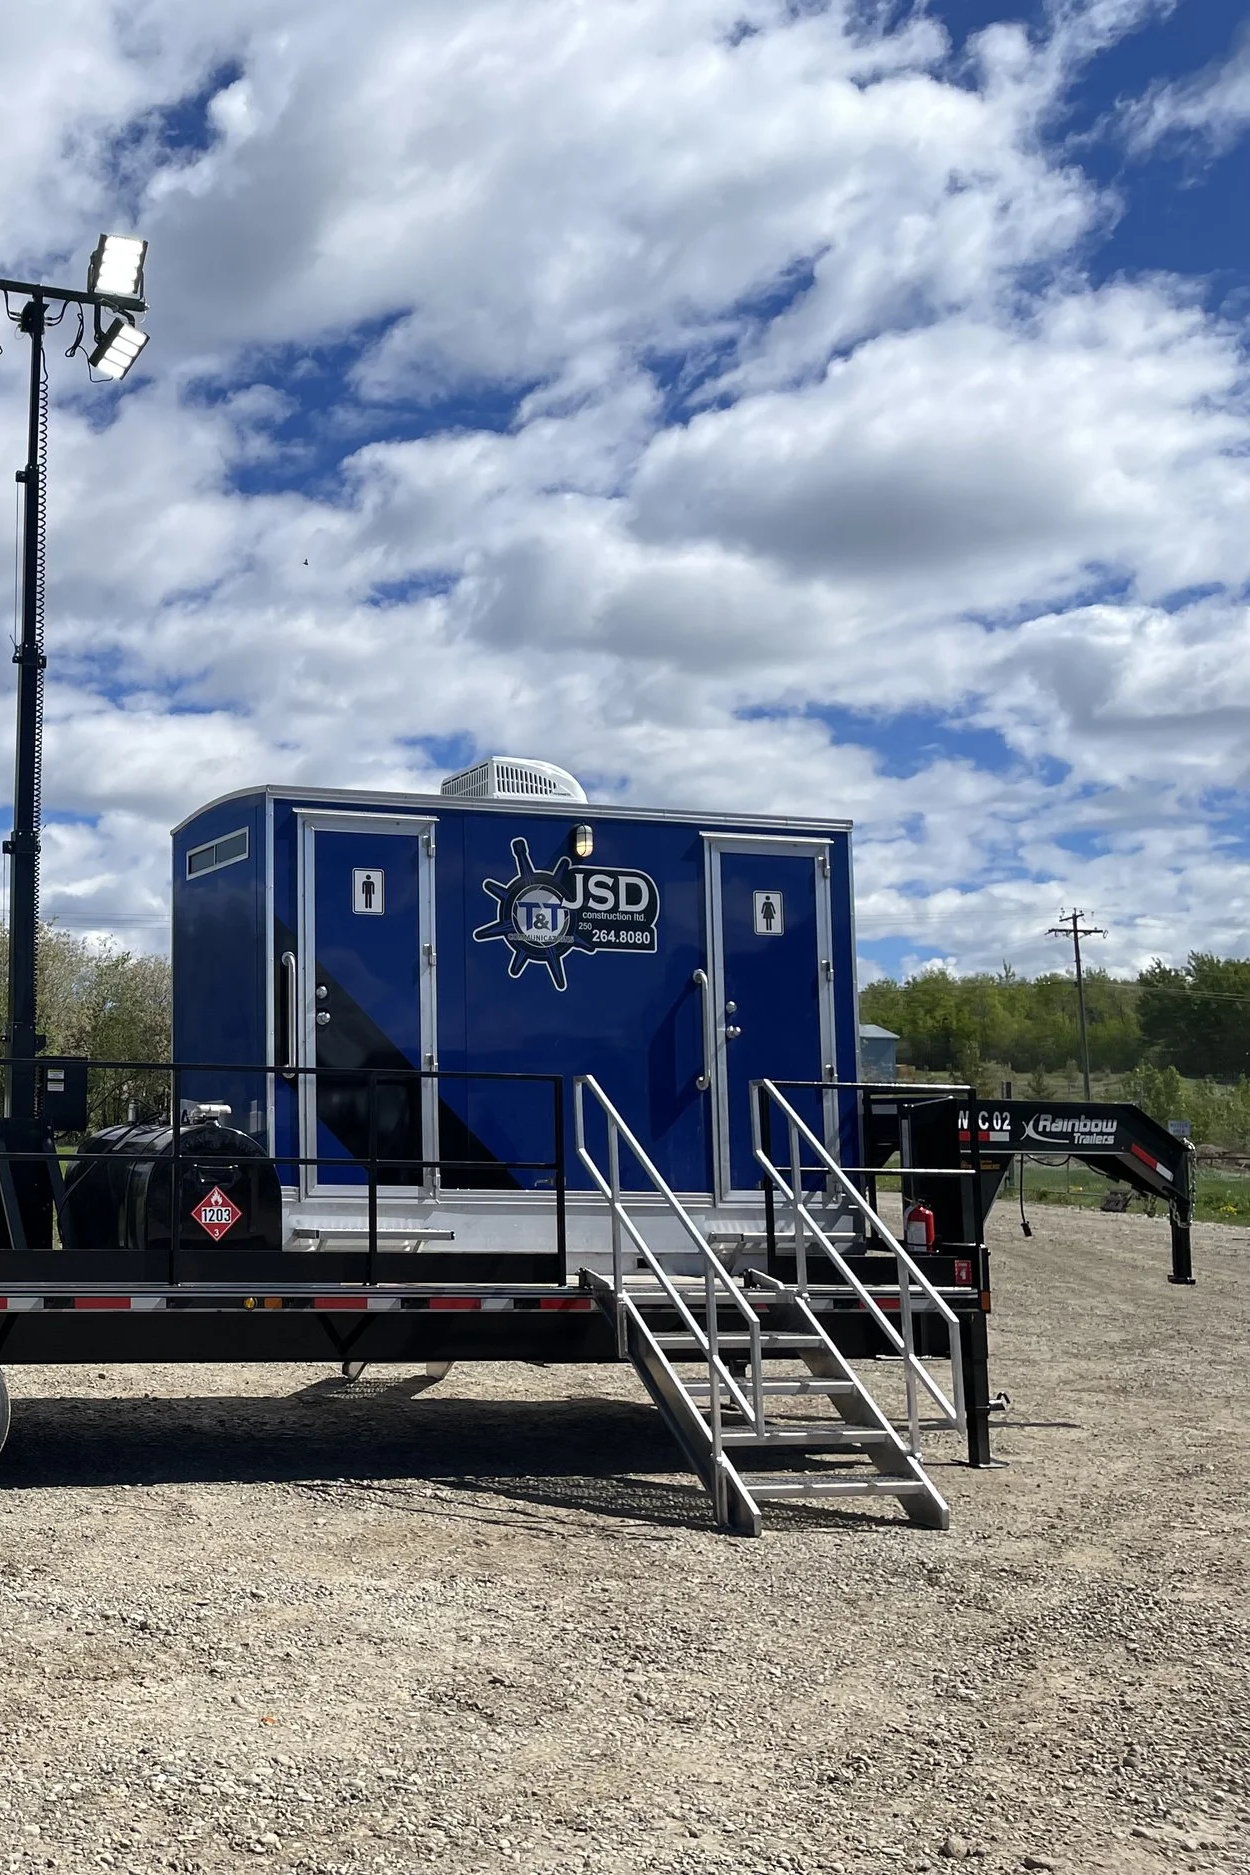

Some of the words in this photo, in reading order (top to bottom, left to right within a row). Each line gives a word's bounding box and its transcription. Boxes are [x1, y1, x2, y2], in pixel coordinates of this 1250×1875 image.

[561, 873, 650, 912] JSD
[517, 900, 563, 933] T&T
[582, 911, 632, 921] construction
[633, 913, 647, 922] ltd.
[578, 922, 593, 931] 250
[592, 929, 651, 944] 264.8080
[993, 1111, 1011, 1130] 02
[1038, 1114, 1118, 1133] Rainbow
[1073, 1132, 1115, 1144] Trailers
[202, 1208, 231, 1222] 1203
[214, 1228, 220, 1237] 3
